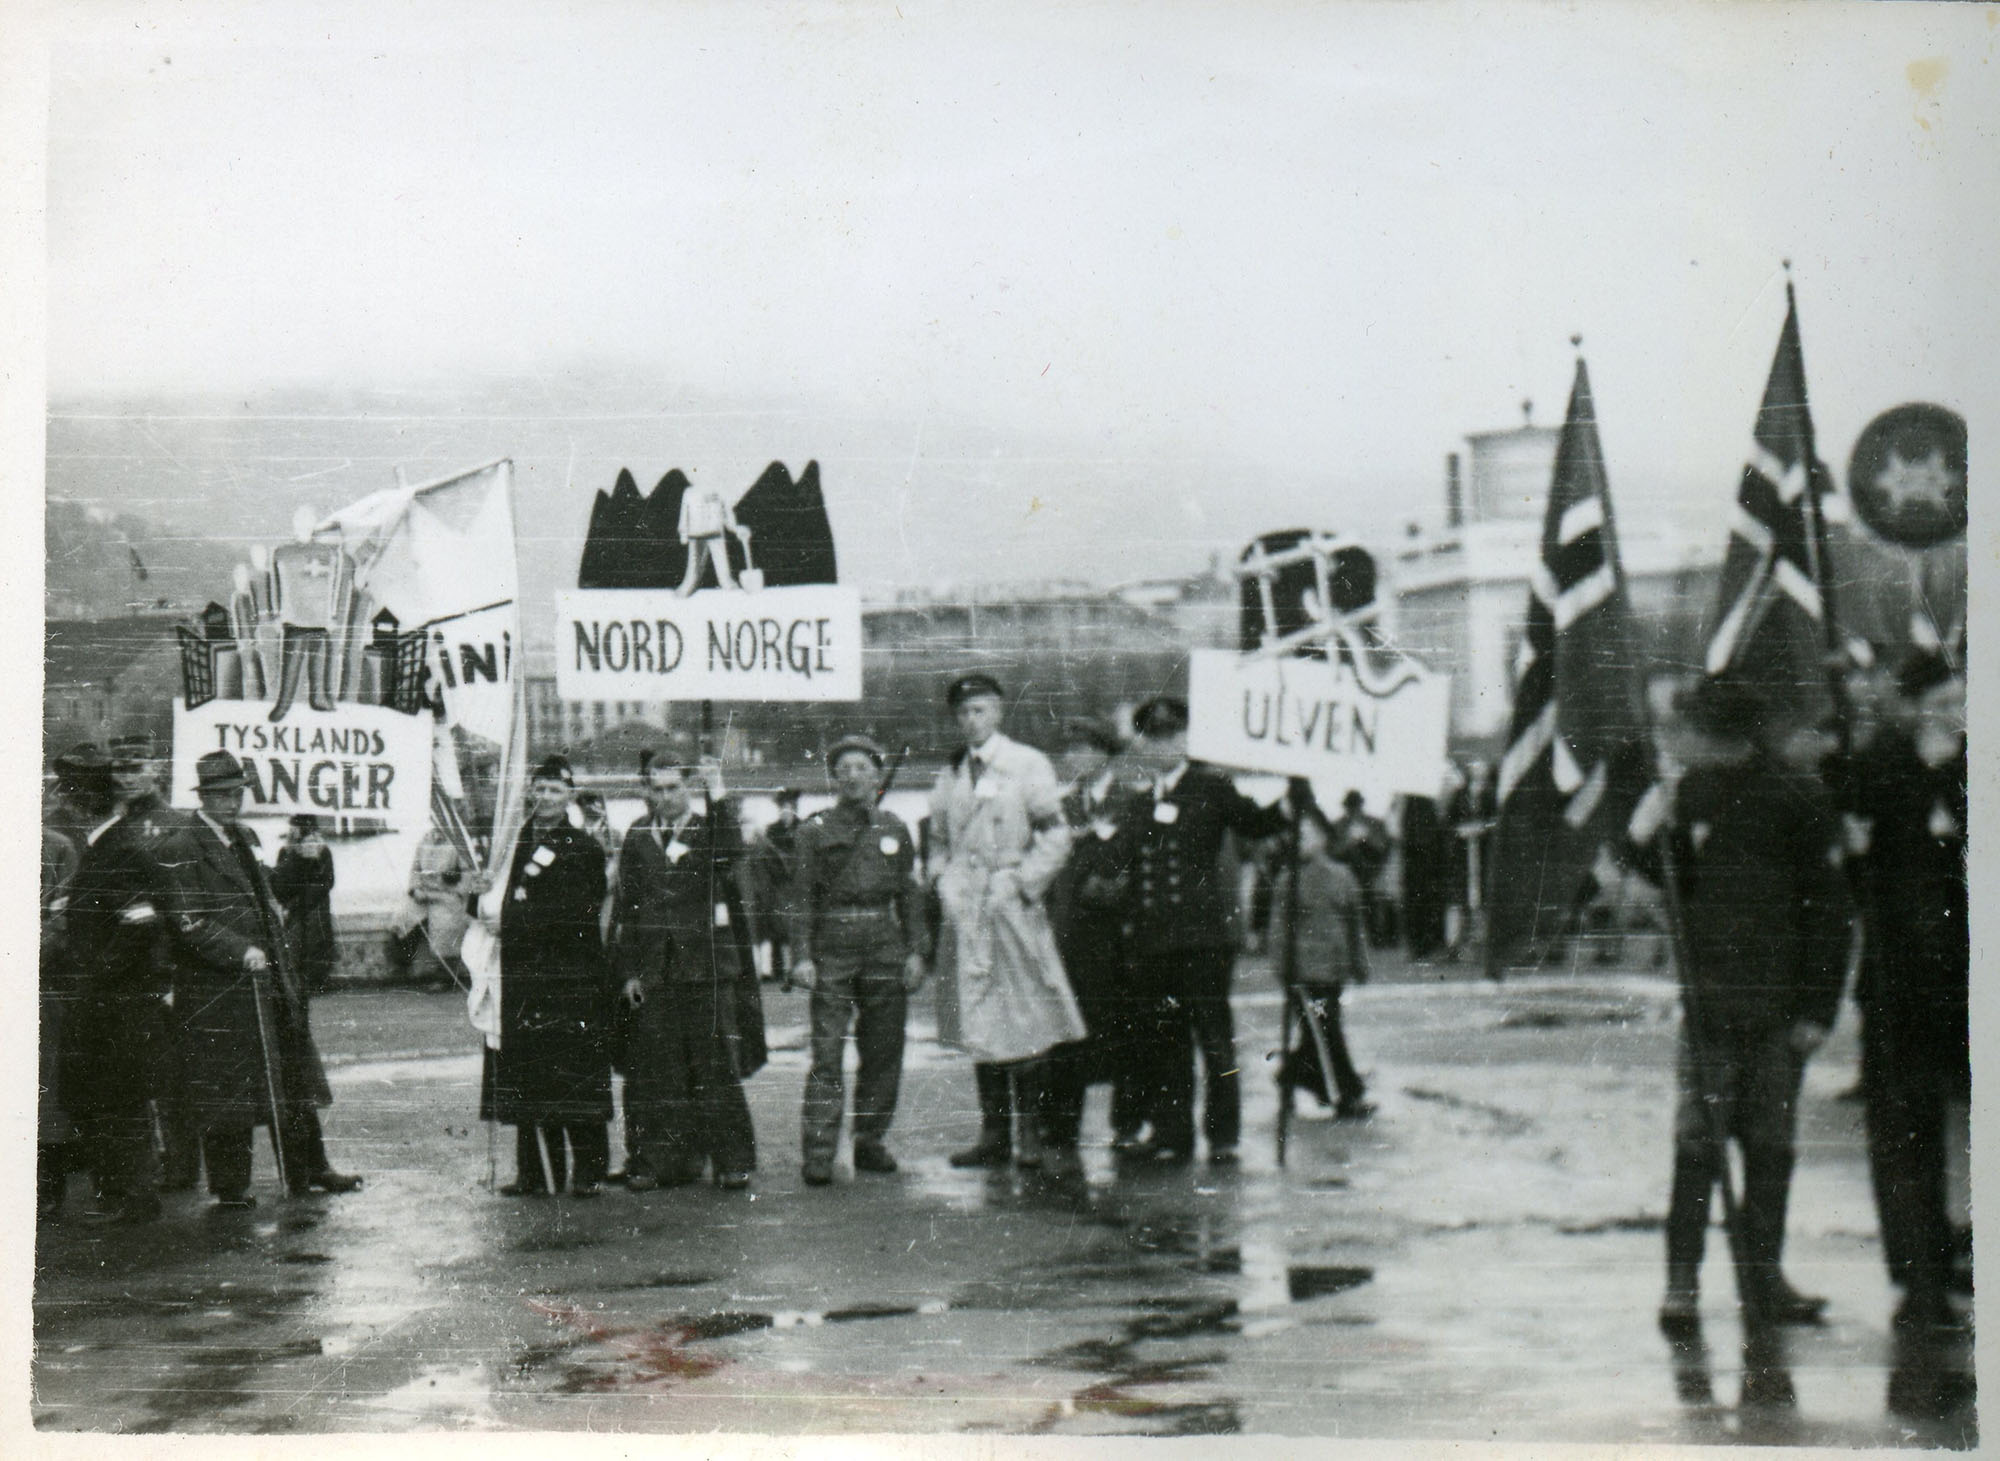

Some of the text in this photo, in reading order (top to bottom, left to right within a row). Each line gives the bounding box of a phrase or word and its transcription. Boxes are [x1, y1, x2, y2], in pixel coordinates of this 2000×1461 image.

[573, 618, 834, 679] NORD NORGE
[214, 723, 386, 756] TYSKLANDS
[1244, 689, 1378, 754] ULVEN
[242, 756, 395, 811] ANGER
